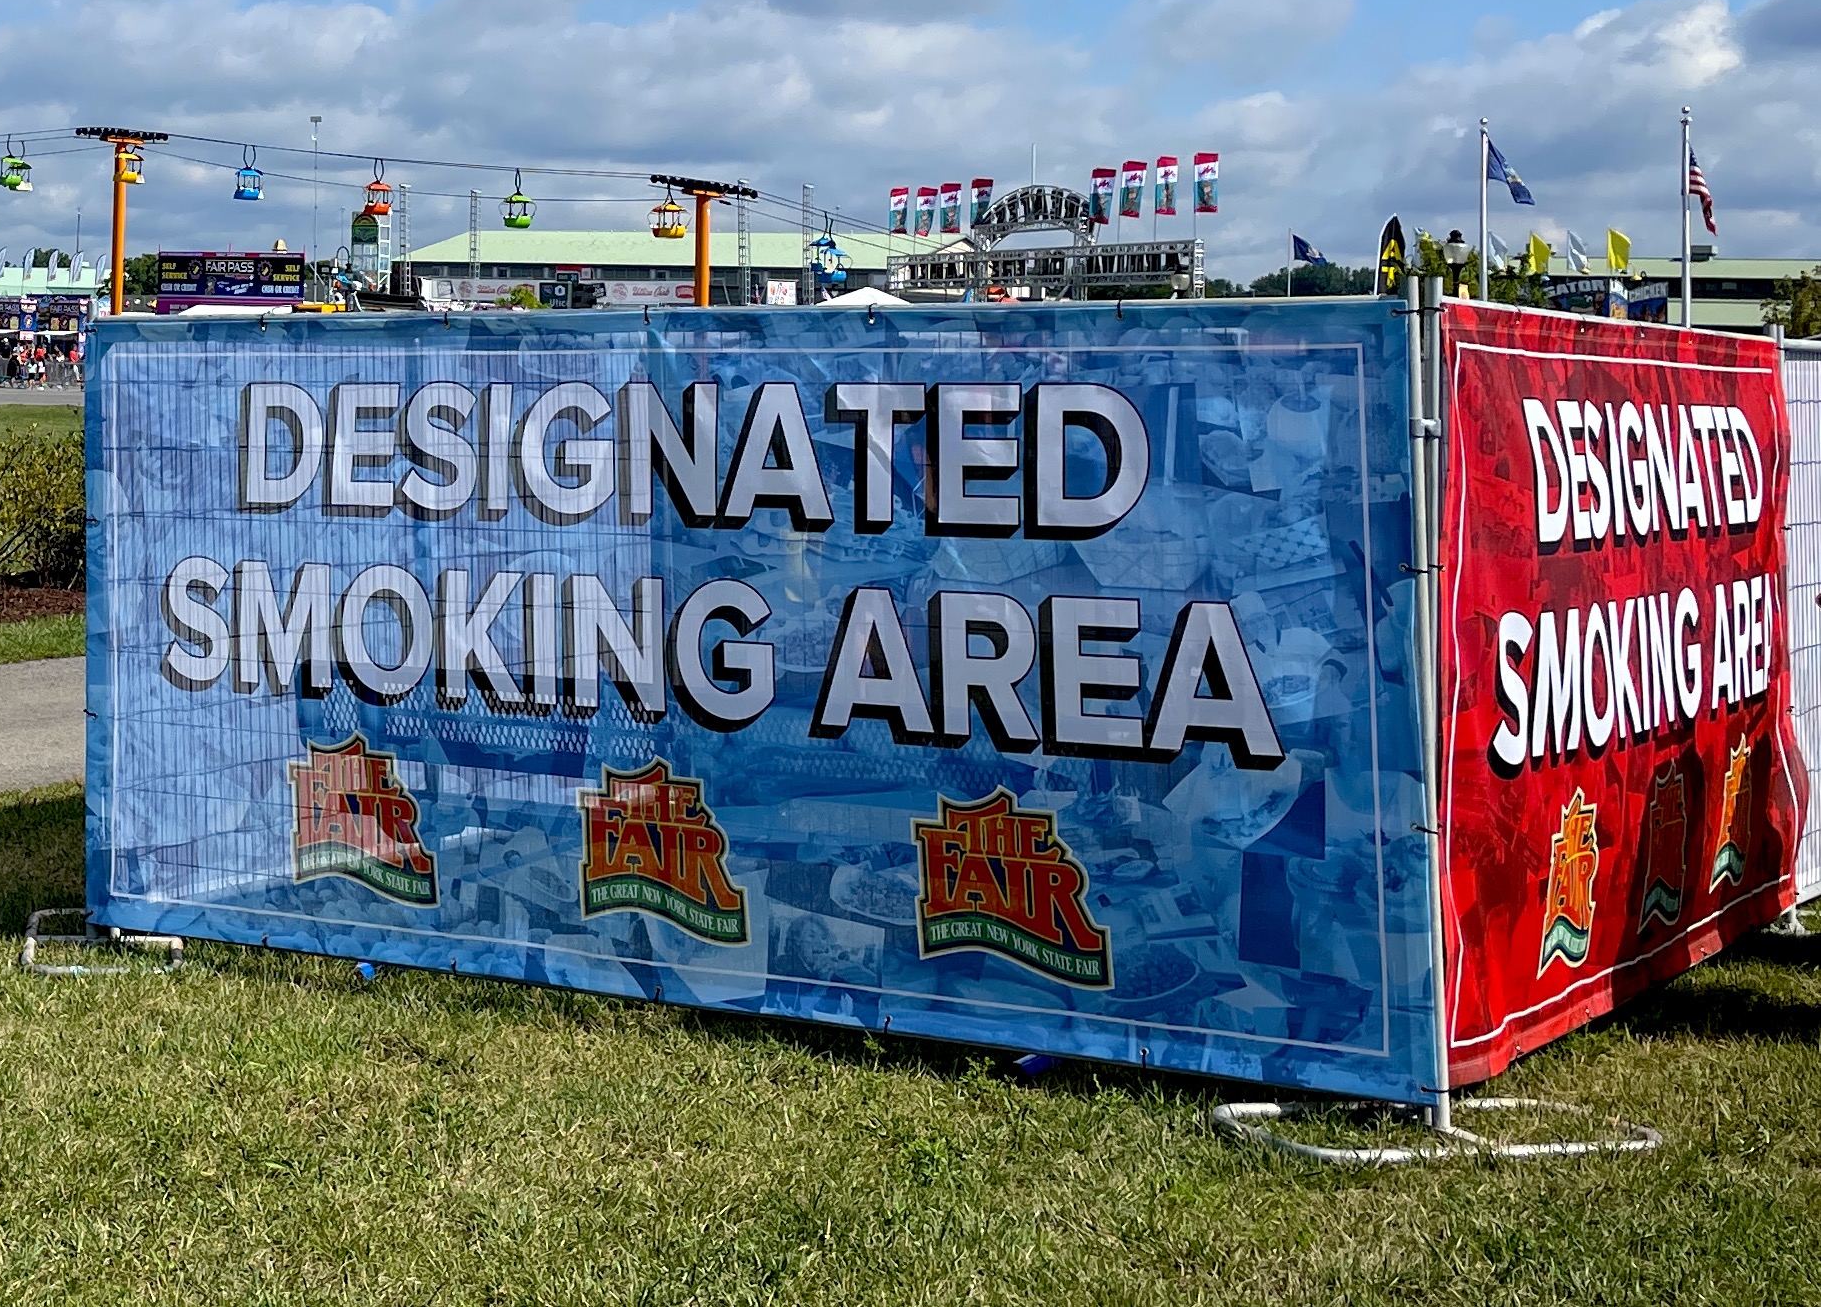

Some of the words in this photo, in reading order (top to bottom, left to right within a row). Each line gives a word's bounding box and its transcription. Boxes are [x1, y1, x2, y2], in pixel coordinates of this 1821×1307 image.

[205, 261, 226, 273] FAIR
[228, 261, 255, 273] PASS
[550, 298, 566, 308] Utic
[240, 381, 1150, 538] DESIGNATED
[1521, 398, 1764, 552] DESIGNATED
[161, 556, 775, 732] SMOKING
[810, 586, 1285, 770] AREA
[1489, 587, 1702, 775] SMOKING
[1711, 573, 1773, 710] AREA
[313, 742, 401, 798] THE
[610, 766, 706, 827] THE
[293, 769, 431, 874] FAIR
[585, 796, 740, 910] FAIR
[946, 797, 1061, 864] THE
[362, 861, 384, 882] YORK
[385, 872, 411, 893] STATE
[412, 880, 431, 895] FAIR
[592, 886, 609, 903] THE
[610, 884, 639, 902] GREAT
[642, 885, 661, 904] NEW
[665, 894, 687, 918] YORK
[689, 908, 715, 931] STATE
[717, 917, 739, 933] FAIR
[919, 828, 1102, 950] FAIR
[930, 924, 950, 941] THE
[951, 921, 982, 939] GREAT
[986, 924, 1008, 944] NEW
[1011, 935, 1040, 960] YORK
[1042, 948, 1073, 974] STATE
[1075, 958, 1100, 975] FAIR
